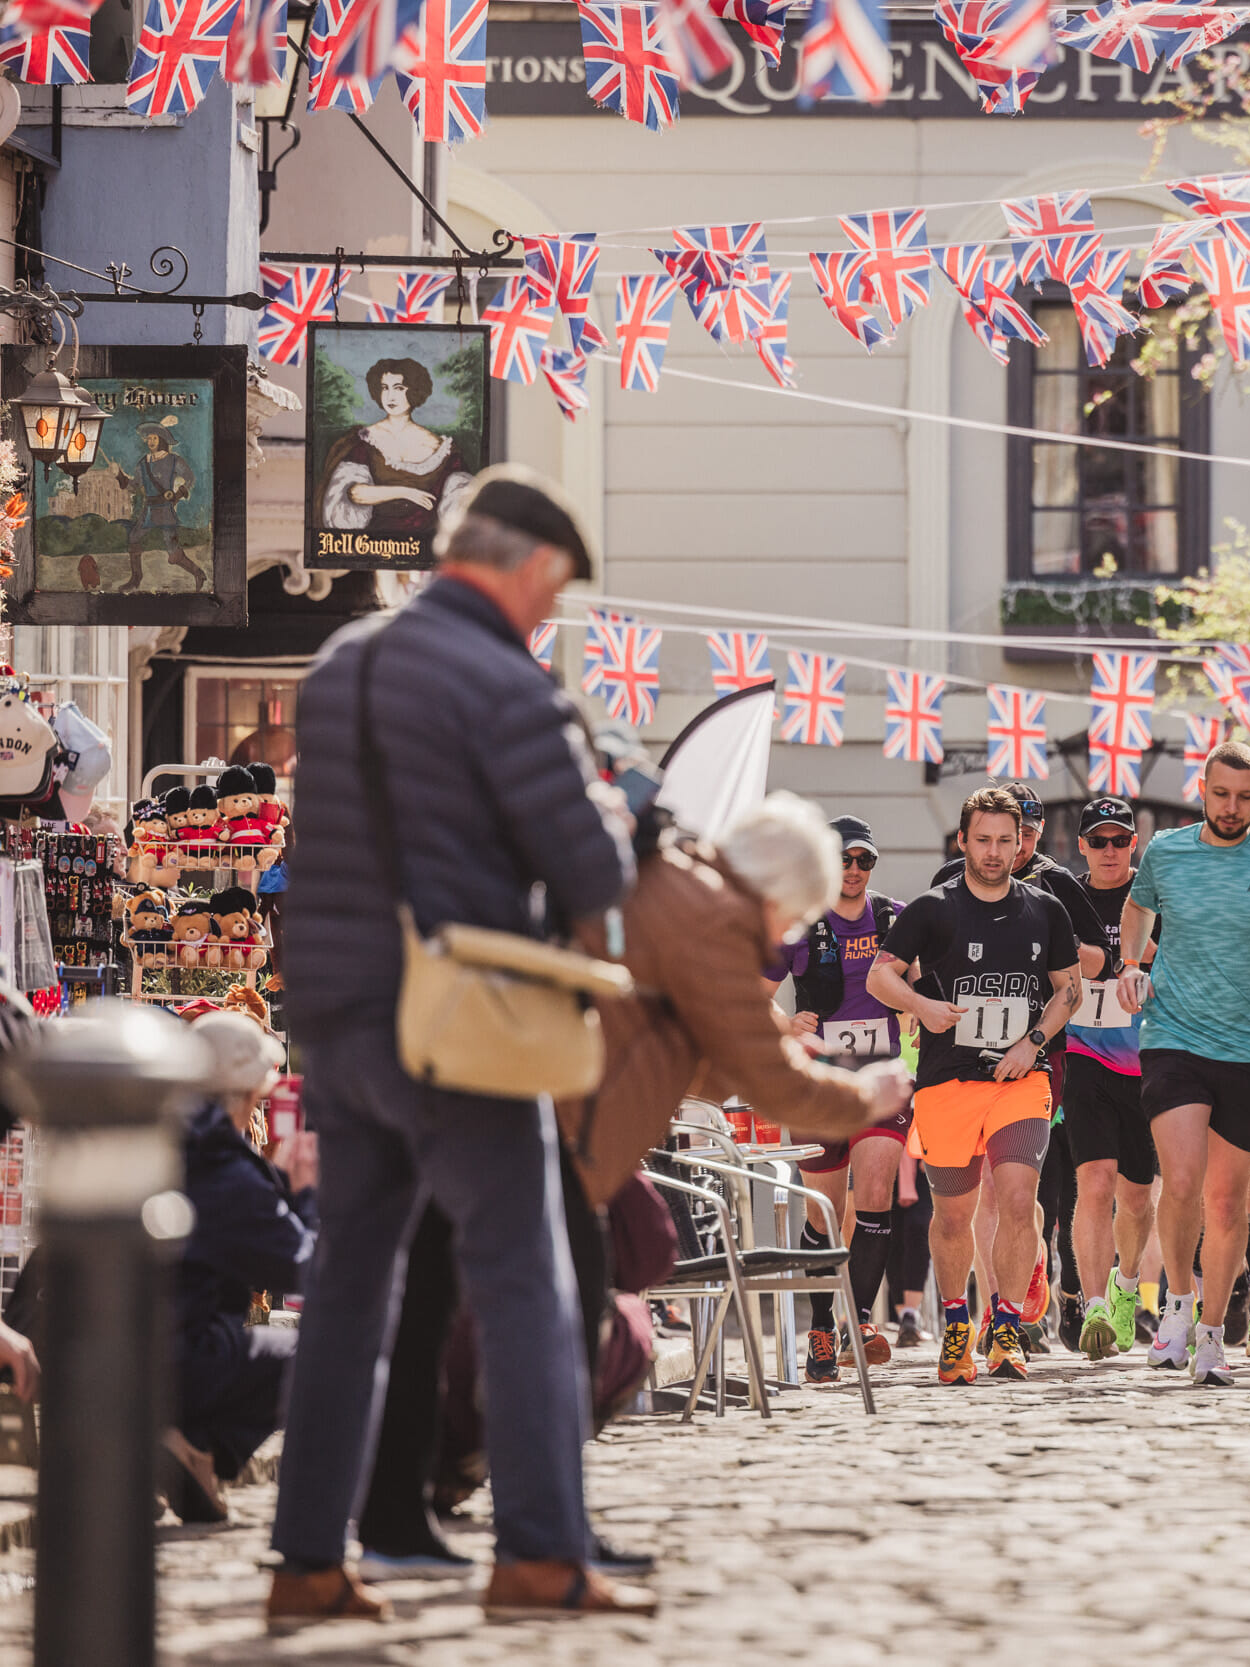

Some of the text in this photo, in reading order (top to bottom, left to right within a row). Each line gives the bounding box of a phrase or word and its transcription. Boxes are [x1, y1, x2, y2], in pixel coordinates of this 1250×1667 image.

[122, 386, 199, 412] House
[318, 532, 421, 560] Nell Gwynn's
[844, 949, 880, 960] RUNN
[1089, 988, 1106, 1020] 7
[974, 1006, 1010, 1041] 11
[838, 1028, 877, 1056] 37
